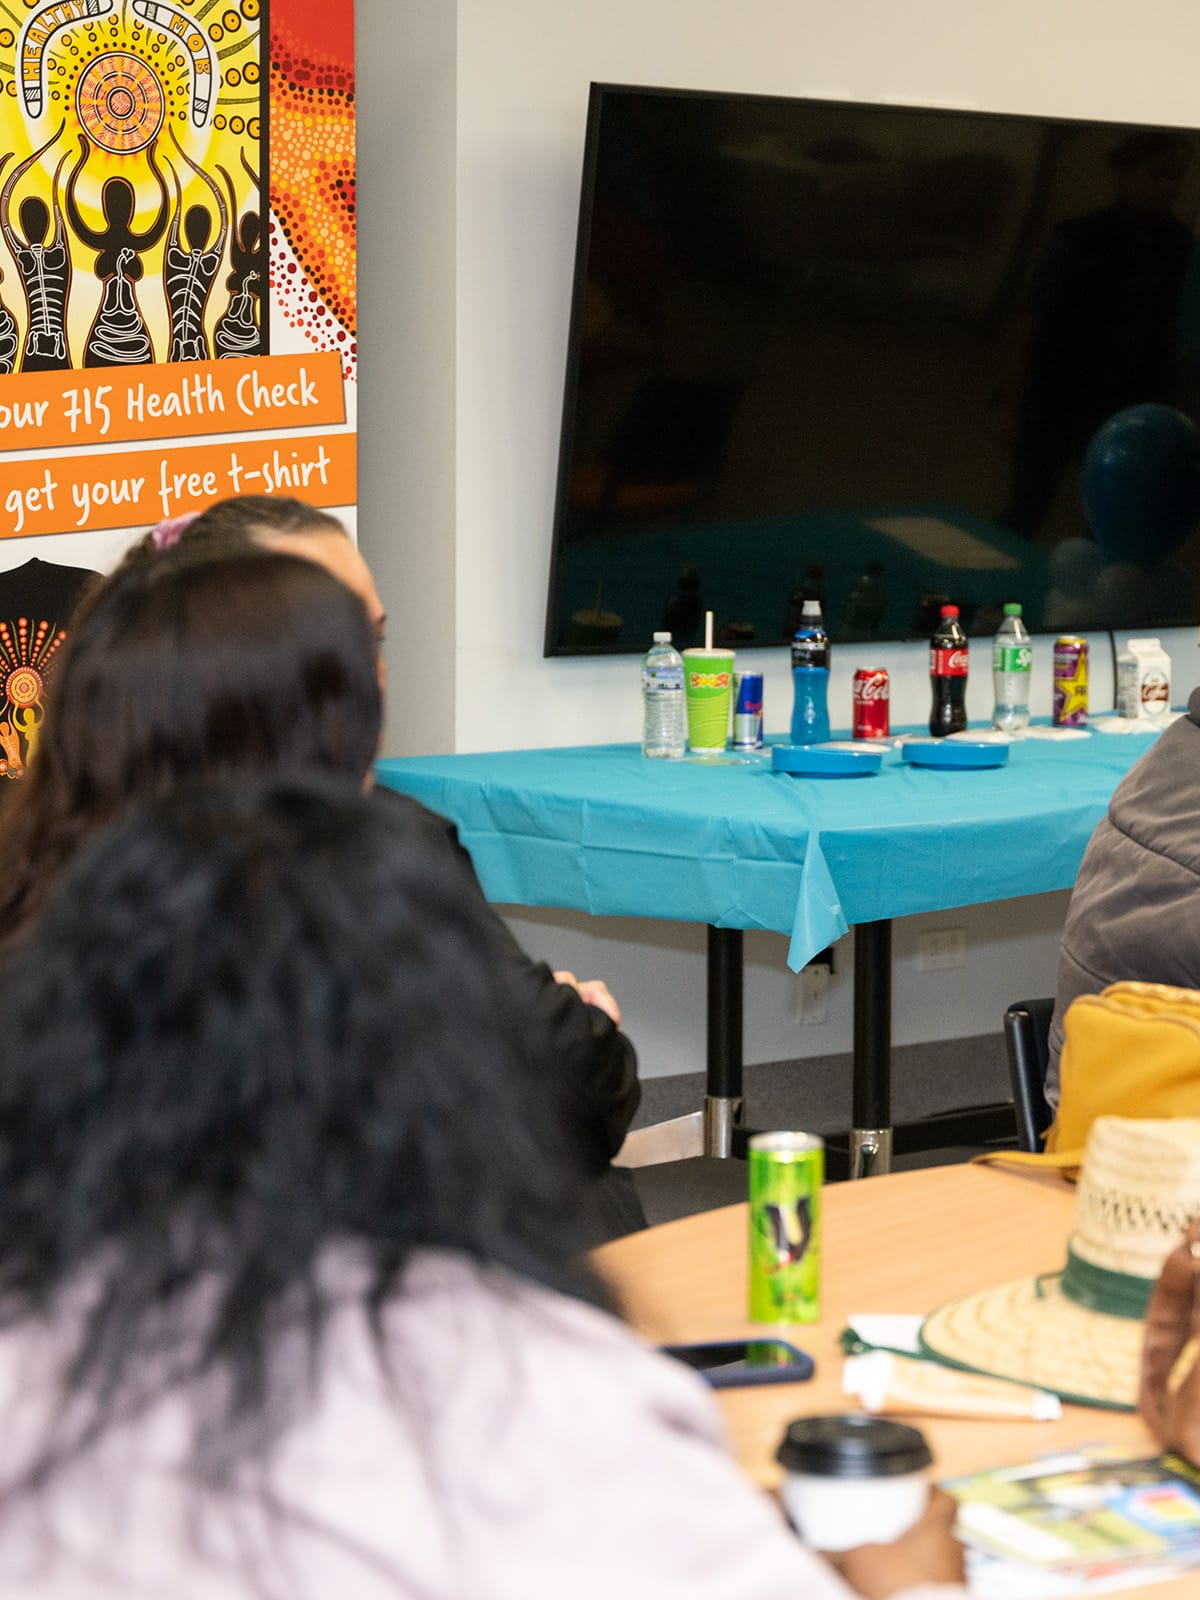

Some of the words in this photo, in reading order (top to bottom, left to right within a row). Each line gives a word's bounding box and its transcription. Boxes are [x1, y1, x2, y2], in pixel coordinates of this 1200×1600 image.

[23, 0, 87, 81] HEALTHY
[170, 14, 212, 76] MOB
[62, 385, 113, 435] 715
[127, 372, 225, 422] Health
[236, 367, 320, 416] Check
[5, 469, 58, 532] get
[72, 477, 145, 526] your
[158, 460, 218, 517] free
[227, 445, 331, 493] t-shirt
